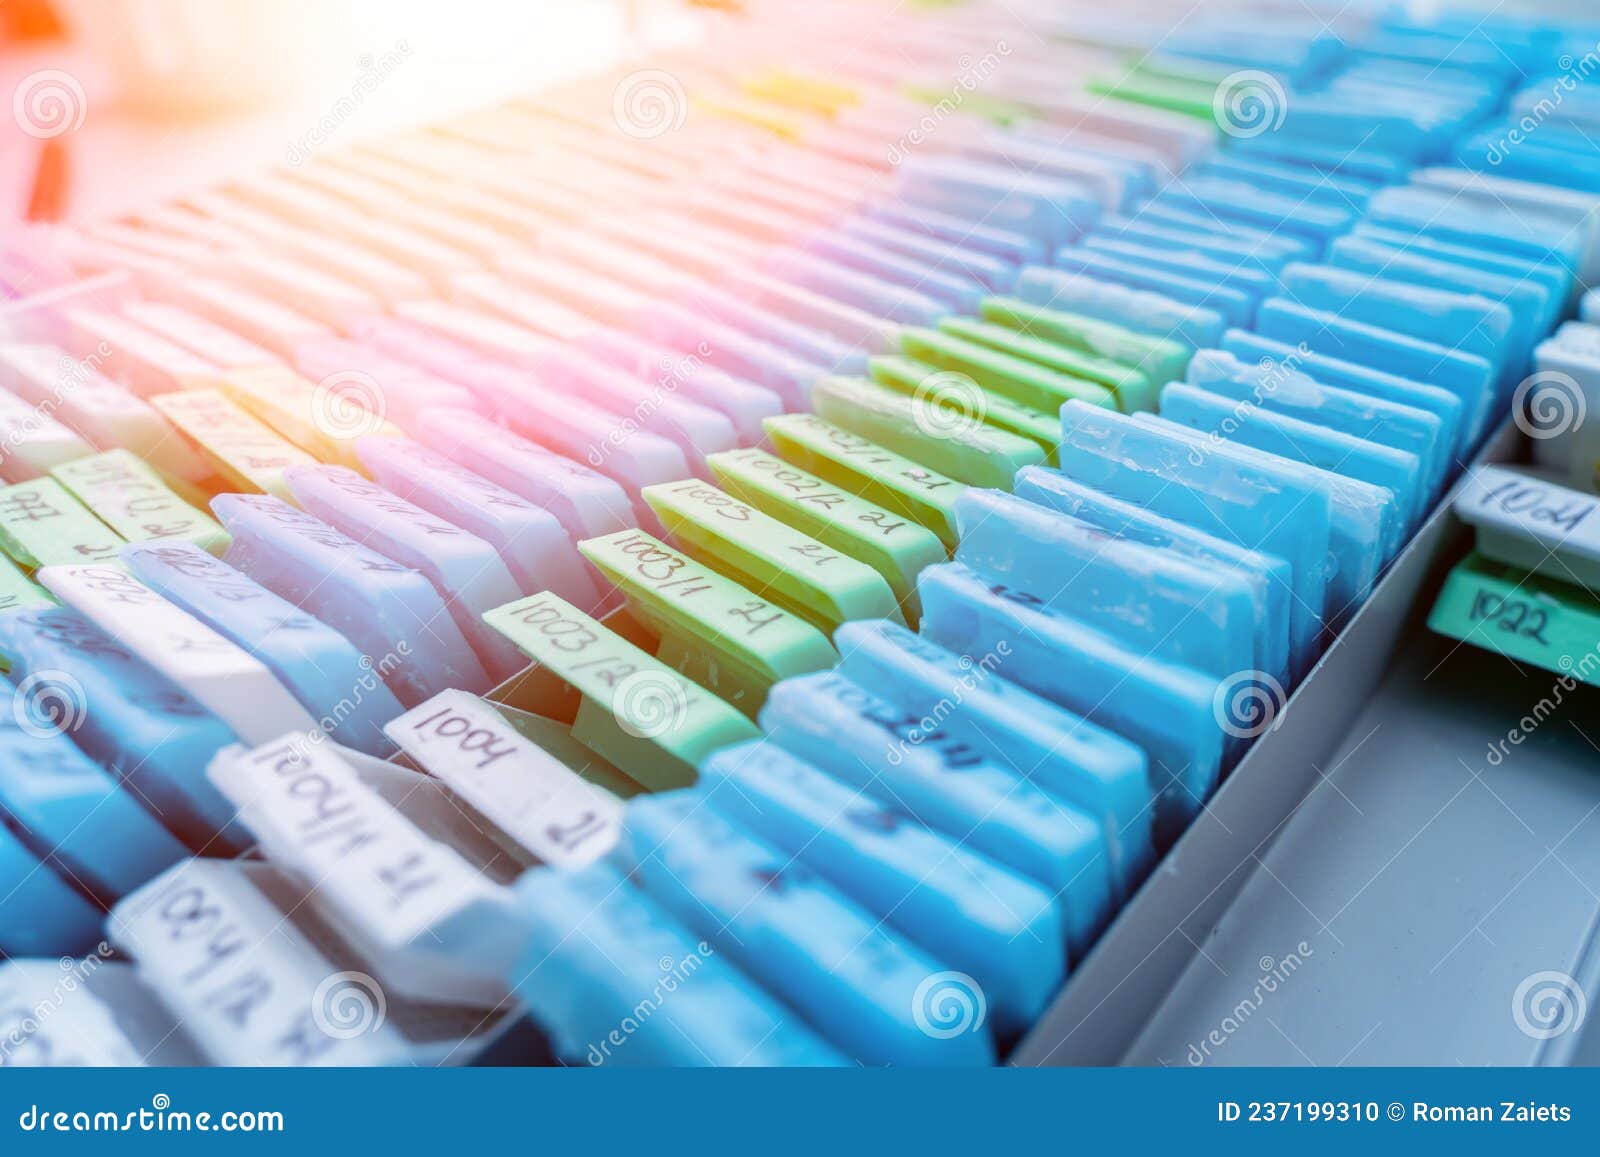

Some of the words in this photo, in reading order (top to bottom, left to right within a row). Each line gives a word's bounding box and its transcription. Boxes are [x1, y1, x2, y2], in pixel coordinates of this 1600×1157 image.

[672, 485, 750, 521] 1003
[789, 544, 838, 566] 21
[858, 511, 906, 535] 21
[613, 535, 712, 597] 1003/1
[728, 601, 784, 634] 21
[1468, 588, 1551, 647] 1022
[414, 708, 518, 769] 1004
